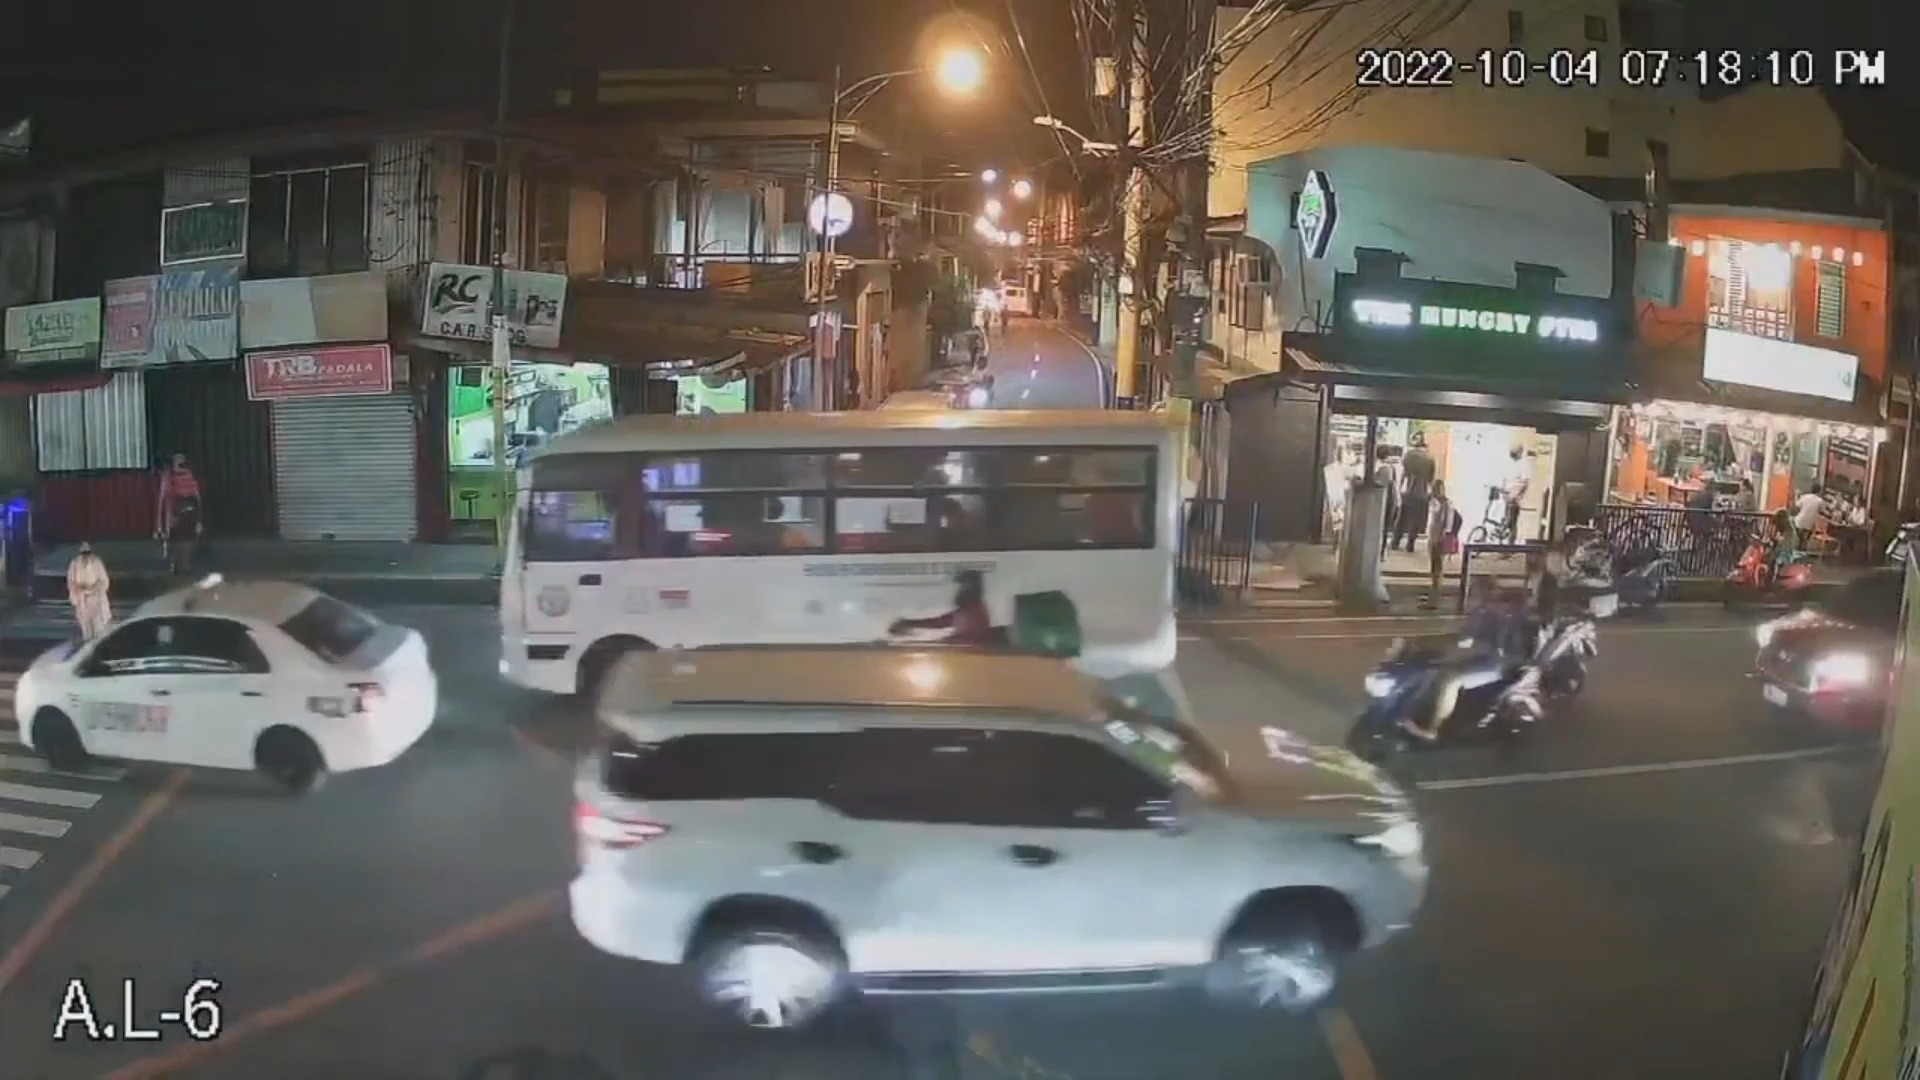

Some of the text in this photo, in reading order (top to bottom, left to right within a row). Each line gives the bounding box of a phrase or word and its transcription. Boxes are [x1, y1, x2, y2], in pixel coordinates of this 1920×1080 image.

[1420, 305, 1531, 335] HUNGRY
[440, 321, 477, 338] CAR
[318, 362, 373, 375] PADALA
